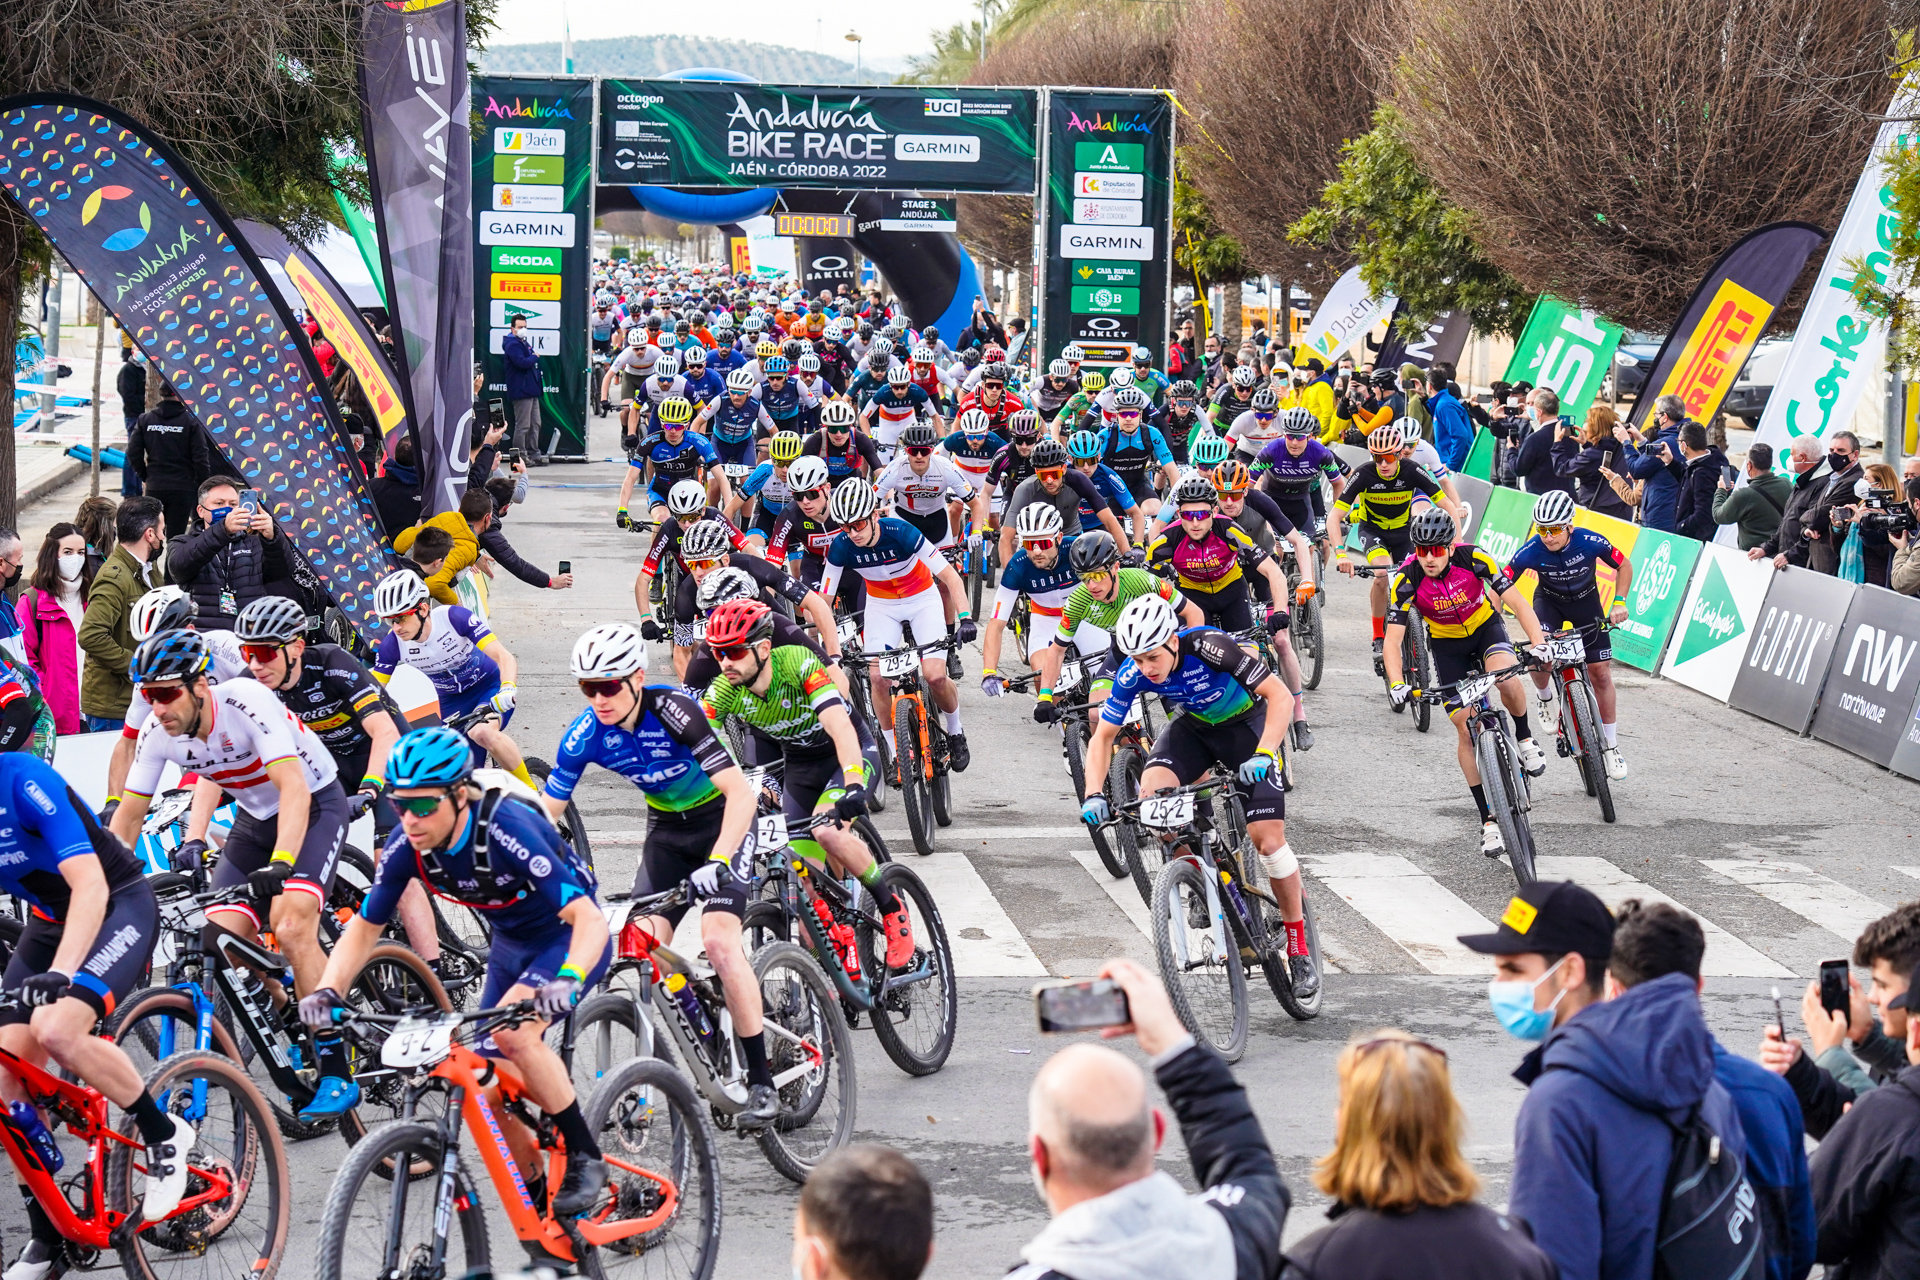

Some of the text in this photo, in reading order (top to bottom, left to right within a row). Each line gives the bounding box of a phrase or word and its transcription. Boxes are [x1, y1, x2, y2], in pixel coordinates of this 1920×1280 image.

[484, 96, 576, 121] Andalucía
[617, 93, 664, 109] octagon
[931, 102, 958, 113] UCI
[726, 92, 886, 133] Andalucía
[1067, 111, 1154, 134] Andalucía
[525, 132, 557, 147] Jaén
[728, 131, 796, 158] BIKE
[804, 132, 886, 160] RACE
[903, 142, 971, 154] GARMIN
[728, 161, 887, 178] JAÉN CÓRDOBA 2022
[900, 210, 938, 219] ANDÚJAR
[902, 200, 937, 209] STAGE 3
[489, 223, 564, 236] GARMIN
[1070, 236, 1142, 249] GARMIN
[499, 253, 555, 268] ŠKODA
[500, 280, 552, 293] PIRELLI
[807, 271, 854, 281] OAKLEY
[1331, 297, 1375, 340] Jaén
[1674, 299, 1755, 418] PIRELLI
[1274, 467, 1319, 475] CANYON
[776, 519, 793, 549] TADDEI
[1478, 522, 1520, 564] ŠKODA
[1583, 534, 1613, 550] TEXPA
[651, 534, 669, 561] TADDEI
[856, 549, 896, 564] GOBIK
[1031, 569, 1074, 589] GOBIK
[1541, 566, 1590, 576] TEXPA
[1693, 598, 1736, 640] El Corte Inglés
[1202, 640, 1226, 658] TRUE
[1554, 642, 1578, 655] 26-1
[1750, 606, 1827, 686] GOBIK
[885, 653, 912, 673] 29-2
[1466, 677, 1489, 700] 21-2
[225, 697, 271, 735] BULLS
[663, 698, 692, 727] TRUE
[1839, 692, 1886, 724] northwave
[564, 716, 594, 752] KMC
[558, 768, 579, 780] SWISS
[625, 762, 689, 784] KMC
[26, 780, 55, 814] ABUS
[1256, 807, 1276, 815] SWISS
[319, 824, 345, 885] BULLS
[738, 834, 756, 879] KMC
[1290, 936, 1299, 955] SWISS
[222, 968, 291, 1068] BULLS
[402, 1029, 435, 1056] 9-2
[475, 1094, 535, 1211] SANTA CRUZ
